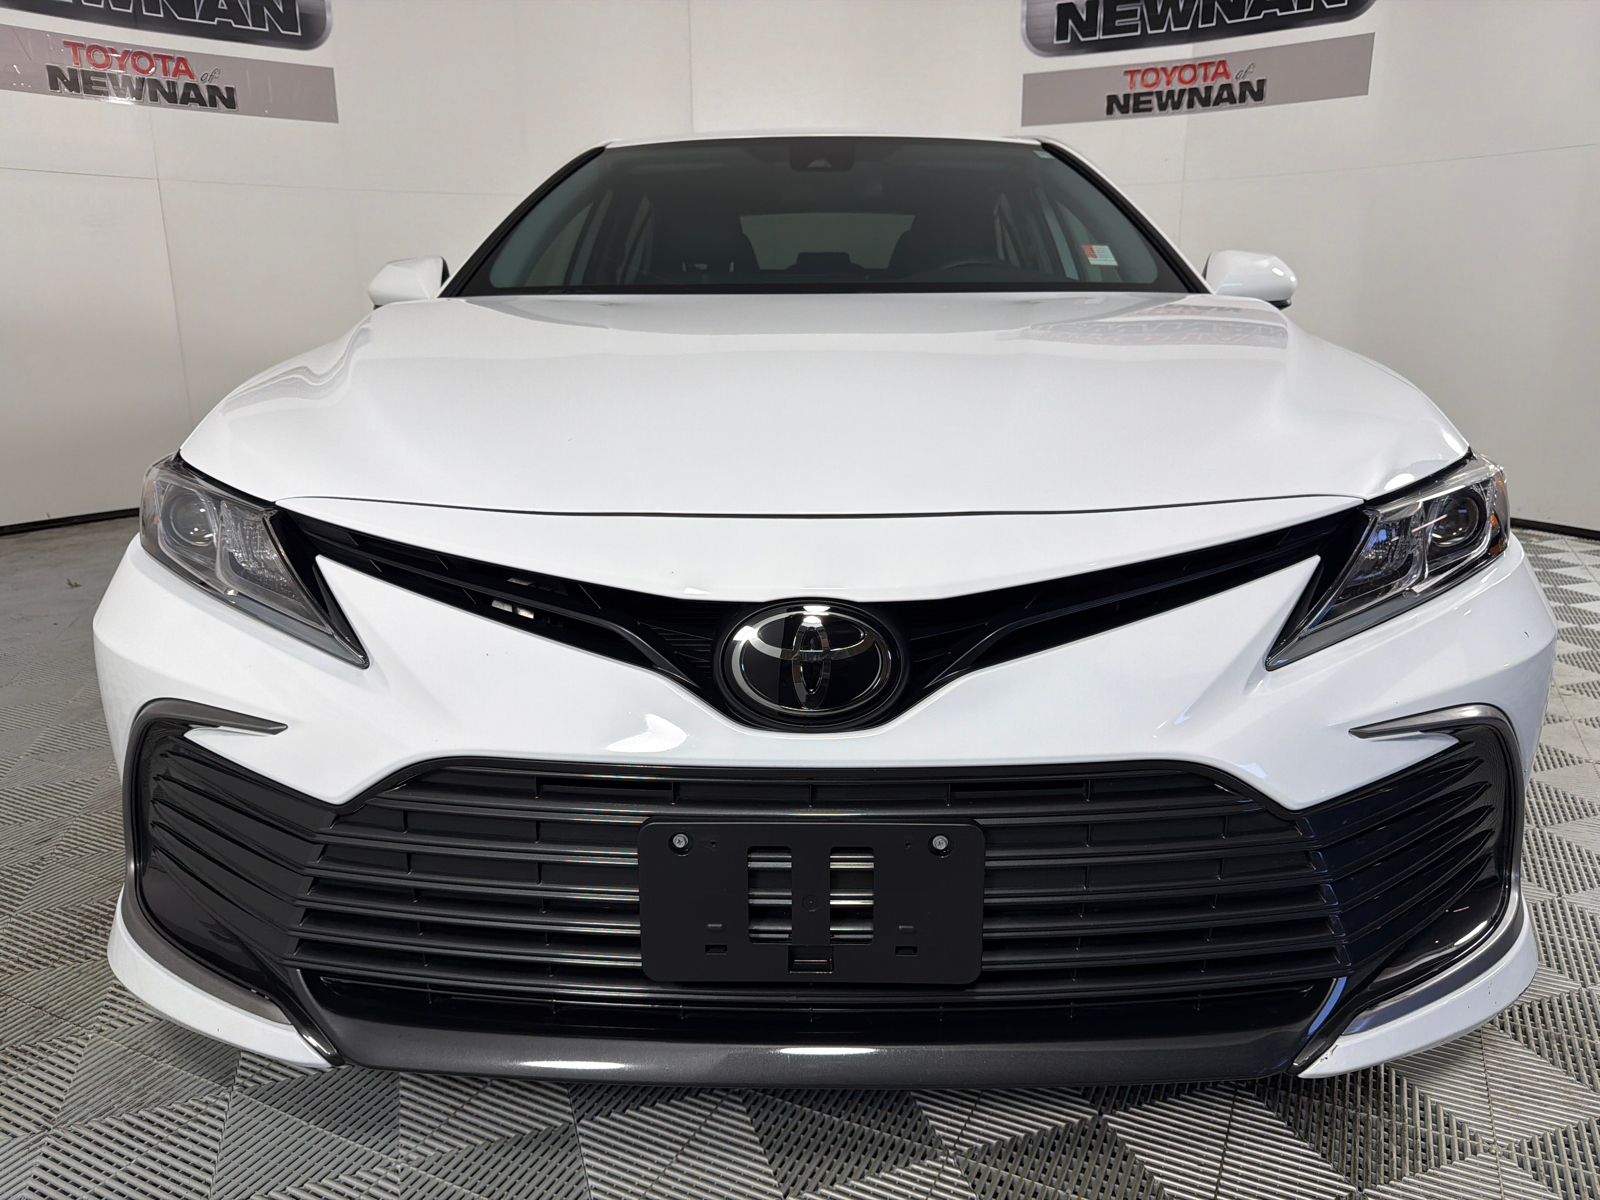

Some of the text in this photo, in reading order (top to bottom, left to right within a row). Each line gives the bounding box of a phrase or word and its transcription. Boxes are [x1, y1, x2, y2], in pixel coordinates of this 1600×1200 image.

[1054, 0, 1349, 44] NEWN
[63, 40, 221, 83] TOYOTA of
[1124, 60, 1255, 91] TOYOTA of
[46, 64, 237, 110] NEWNAN
[1105, 79, 1266, 116] NEWNAN
